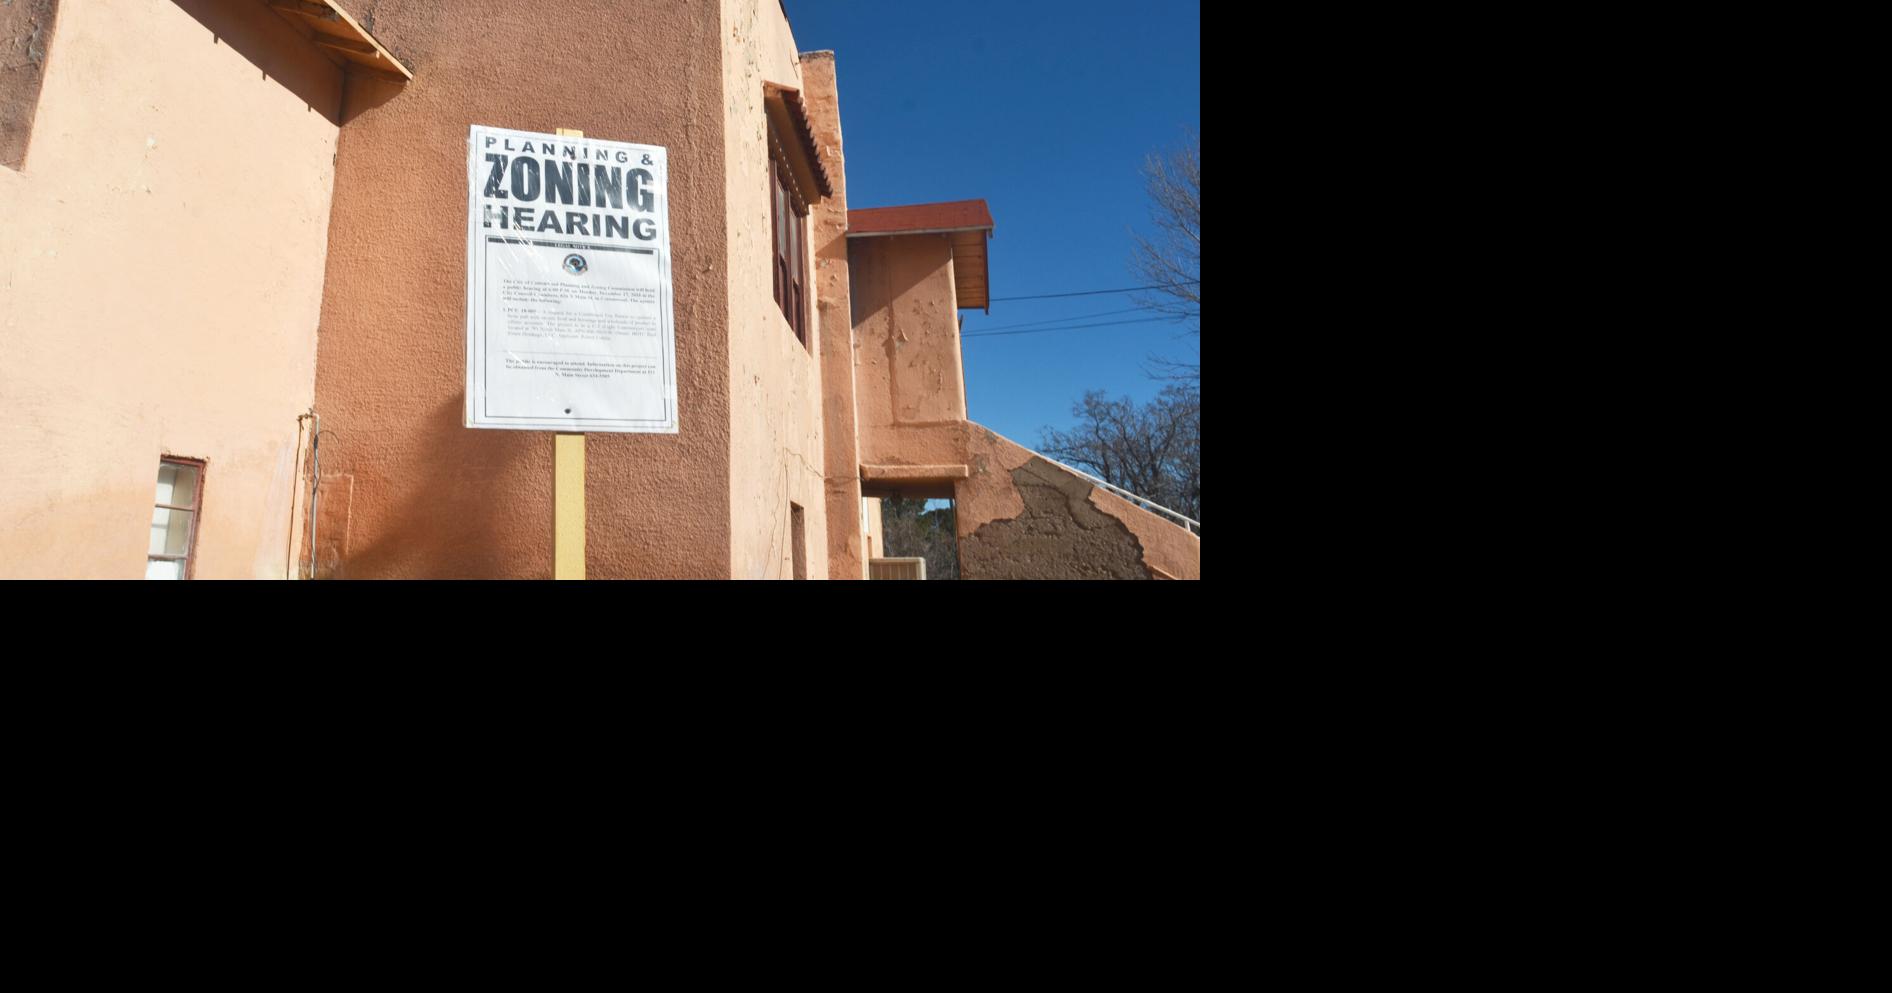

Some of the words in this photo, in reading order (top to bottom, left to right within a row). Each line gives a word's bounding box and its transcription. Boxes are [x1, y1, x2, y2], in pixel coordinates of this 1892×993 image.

[485, 136, 628, 163] PLANNING
[641, 152, 654, 166] &
[484, 152, 654, 212] ZONING
[483, 204, 657, 241] HEARING
